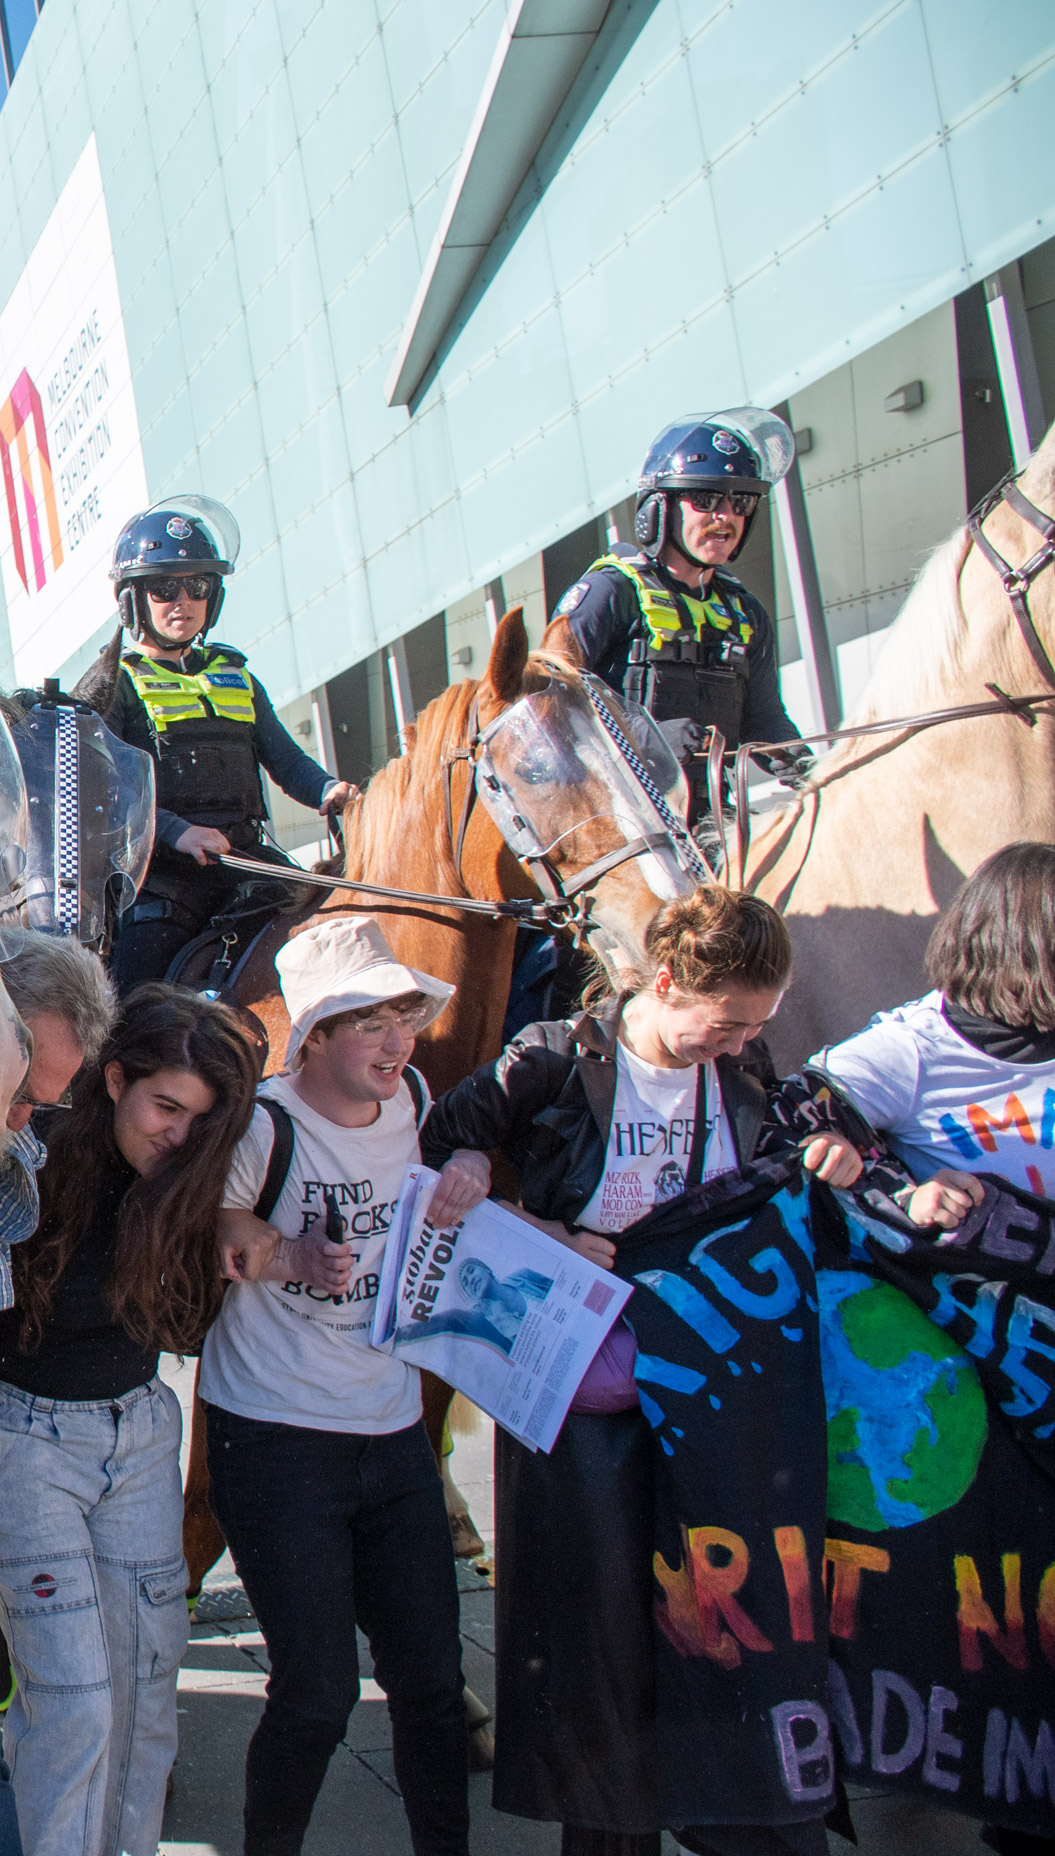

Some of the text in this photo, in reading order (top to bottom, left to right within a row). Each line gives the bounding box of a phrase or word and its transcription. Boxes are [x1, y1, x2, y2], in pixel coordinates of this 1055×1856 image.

[47, 307, 102, 412] MELBOURNE
[54, 357, 110, 460] CONVENTION
[60, 412, 113, 508] EXHIBITION
[66, 485, 102, 552] CENTRE
[601, 1198, 623, 1211] MOD
[603, 1184, 643, 1199] HARAM
